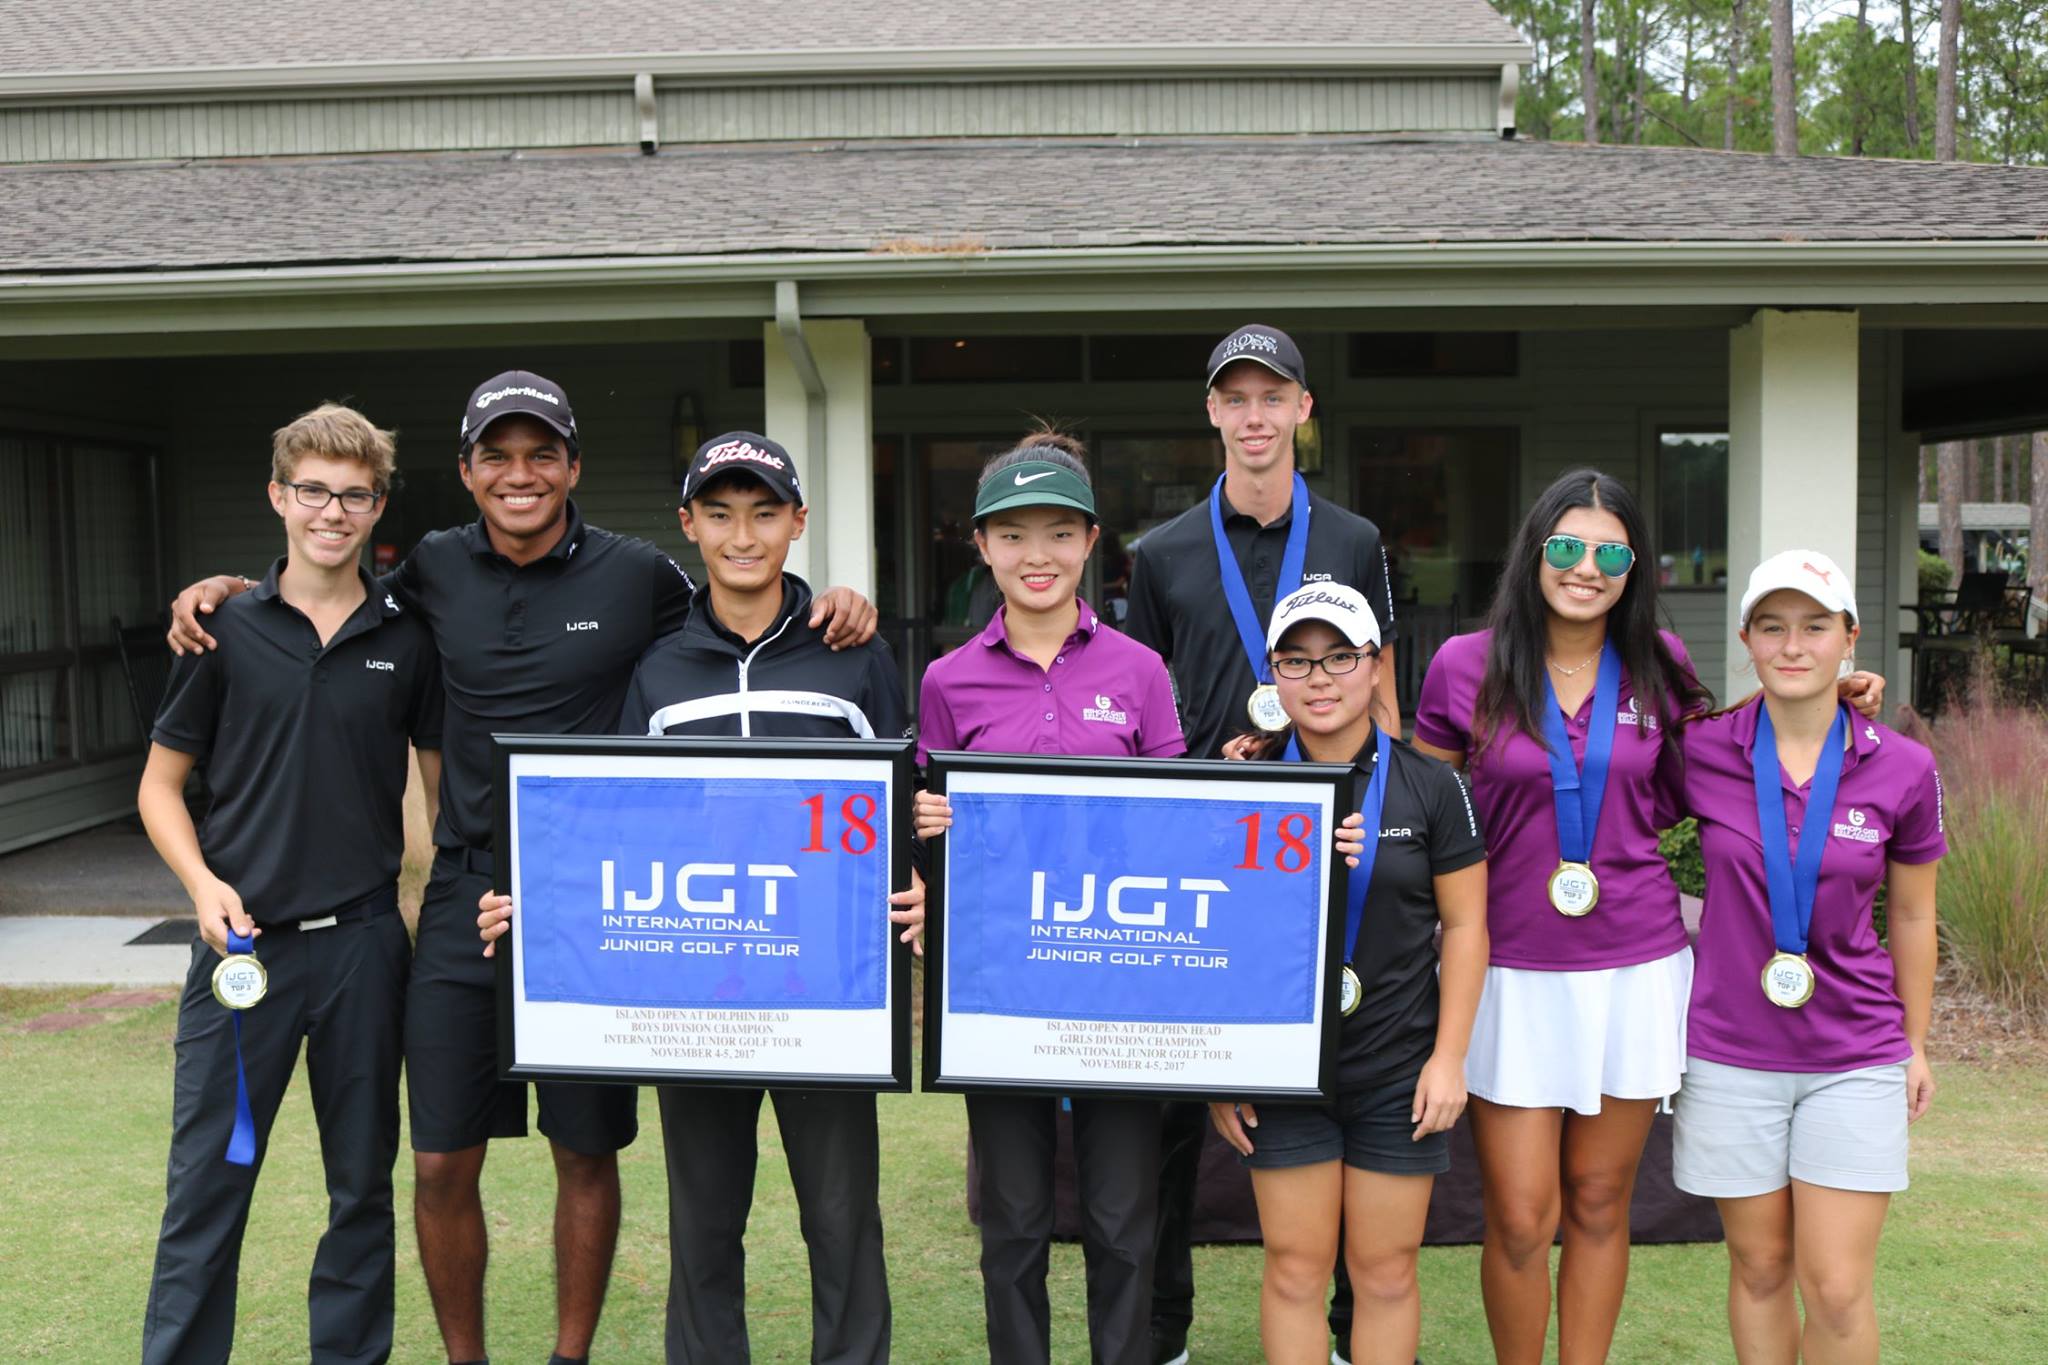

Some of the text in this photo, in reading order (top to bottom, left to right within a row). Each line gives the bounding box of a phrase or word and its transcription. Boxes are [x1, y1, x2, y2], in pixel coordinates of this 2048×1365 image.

[476, 387, 559, 409] TaylorMade
[699, 440, 785, 473] Titleist
[1280, 591, 1358, 619] Titleist
[566, 621, 599, 631] IJGA
[366, 659, 395, 671] IJGA
[800, 792, 877, 855] 18
[1233, 811, 1313, 873] 18
[602, 860, 799, 915] IJGT
[1031, 871, 1231, 928] IJGT
[602, 914, 771, 932] INTERNATIONAL
[1030, 924, 1201, 944] INTERNATIONAL
[599, 938, 800, 957] JUNIOR GOLF TOUR
[1026, 948, 1229, 969] JUNIOR GOLF TOUR
[615, 1009, 789, 1022] ISLAND OPEN AT DOLPHIN HEAD
[631, 1022, 774, 1033] BOYS DIVISION CHAMPION
[1047, 1021, 1221, 1036] ISLAND OPEN AT DOLPHIN HEAD
[604, 1034, 802, 1047] INTERNATIONAL JUNIOR GOLF TOUR
[1059, 1034, 1207, 1047] GIRLS DIVISION CHAMPION
[650, 1048, 756, 1059] NOVEMBER 4-5, 2017
[1033, 1045, 1232, 1060] INTERNATIONAL JUNIOR GOLF TOUR
[1080, 1058, 1185, 1071] NOVEMBER 4-5, 2017
